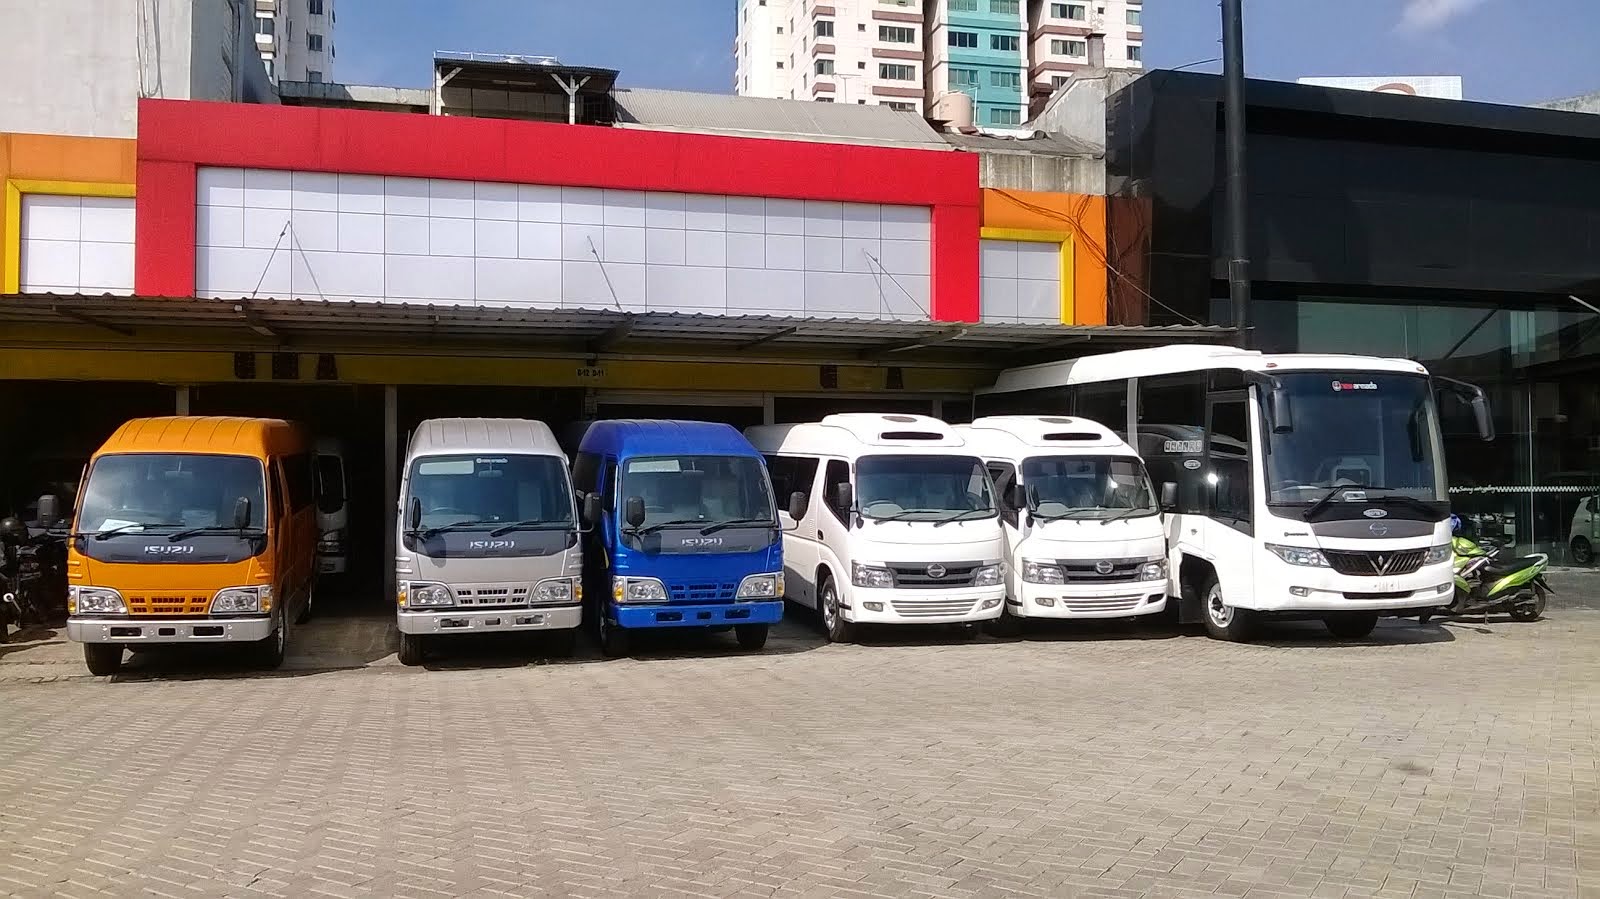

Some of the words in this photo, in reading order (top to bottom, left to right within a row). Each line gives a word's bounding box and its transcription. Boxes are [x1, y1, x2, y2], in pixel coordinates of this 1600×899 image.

[470, 540, 515, 549] ISUZU
[682, 538, 723, 547] ISUZU
[144, 545, 194, 554] ISUZU
